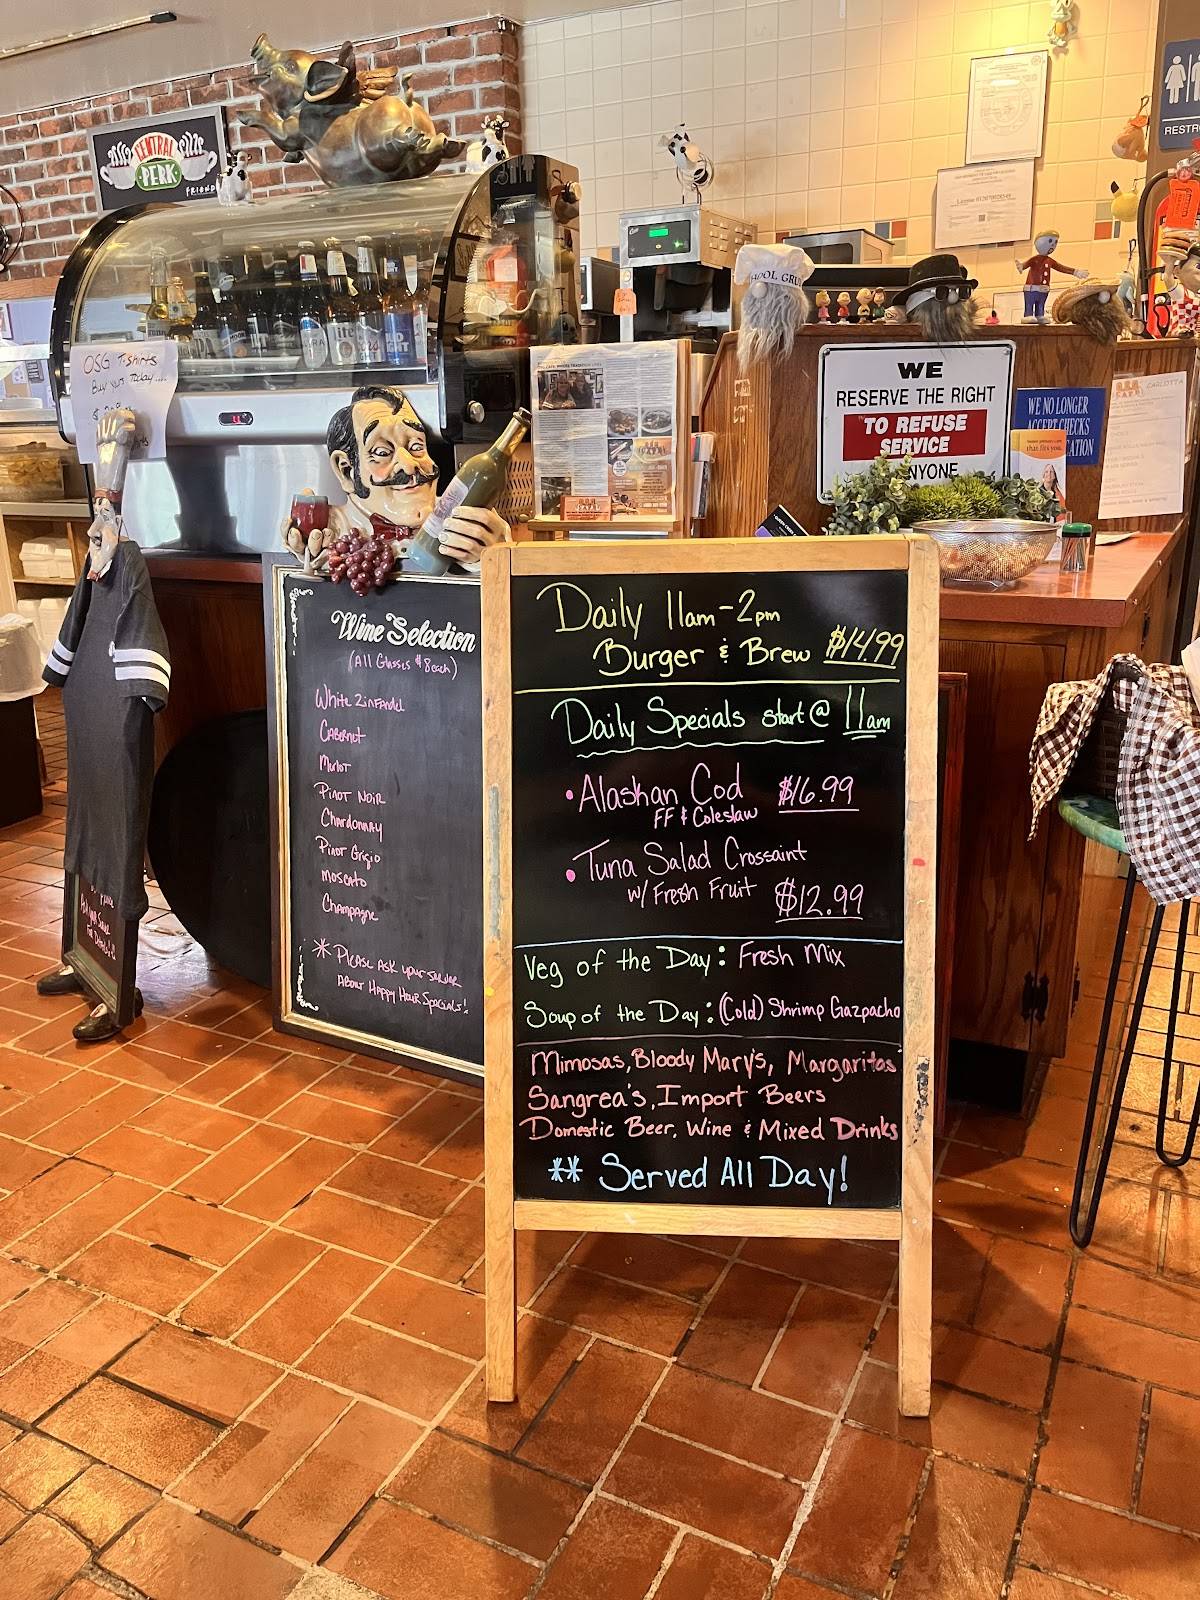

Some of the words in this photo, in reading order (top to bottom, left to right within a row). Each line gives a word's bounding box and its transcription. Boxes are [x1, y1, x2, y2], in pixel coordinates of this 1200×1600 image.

[1164, 124, 1200, 135] RESTR
[134, 135, 174, 161] CENTRAL
[141, 163, 177, 187] PERK
[185, 185, 217, 197] FRIEND
[897, 361, 944, 379] WE
[836, 388, 909, 407] RESERVE
[916, 387, 944, 405] THE
[951, 386, 996, 403] RIGHT
[1028, 397, 1041, 415] WE
[1043, 397, 1055, 415] NO
[1056, 396, 1089, 414] LONGER
[863, 416, 889, 435] TO
[896, 414, 968, 434] REFUSE
[1028, 418, 1058, 429] ACCEPT
[1059, 417, 1090, 435] CHECKS
[880, 436, 950, 456] SERVICE
[905, 462, 958, 480] NYONE
[536, 581, 644, 641] Daily
[331, 611, 384, 642] Wine
[386, 613, 476, 652] Selection
[348, 650, 372, 674] (All
[376, 653, 410, 670] Glasses
[592, 637, 705, 677] Burger
[719, 638, 730, 664] &
[739, 637, 811, 667] Brew
[824, 624, 905, 663] $14.99
[315, 684, 351, 710] White
[551, 697, 636, 747] Daily
[646, 696, 747, 739] Specials
[761, 697, 805, 727] start
[809, 700, 830, 728] @
[844, 685, 891, 731] 11am
[690, 761, 744, 806] Cod
[778, 775, 855, 807] $16.99
[321, 807, 383, 842] Chardonnay
[654, 806, 676, 829] FF
[692, 803, 758, 828] Coleslaw
[351, 844, 381, 870] Grigio
[572, 839, 638, 883] Tuna
[643, 840, 711, 876] Salad
[724, 836, 808, 870] Crossaint
[322, 893, 379, 924] Champagne
[627, 879, 649, 910] w/
[652, 881, 699, 907] Fresh
[708, 875, 757, 901] Fruit
[774, 877, 865, 917] $12.99
[402, 965, 427, 981] your
[523, 955, 564, 988] Veg
[576, 948, 606, 977] of
[616, 946, 651, 973] the
[655, 944, 726, 977] Day:
[738, 940, 794, 969] Fresh
[804, 942, 846, 968] Mix
[523, 1001, 575, 1030] Soup
[581, 1002, 602, 1024] of
[616, 1000, 646, 1023] the
[648, 1000, 714, 1028] Day:
[718, 991, 764, 1027] (Cold)
[769, 997, 825, 1022] Shrimp
[830, 994, 901, 1021] Gazpacho
[531, 1050, 631, 1077] Mimosas,
[631, 1047, 695, 1074] Bloody
[703, 1045, 773, 1080] Mary's,
[788, 1049, 897, 1083] Margaritas
[528, 1083, 655, 1119] Sangrea's,
[655, 1084, 748, 1113] Import
[757, 1083, 826, 1105] Beers
[518, 1116, 615, 1141] Domestic
[686, 1116, 732, 1138] Wine
[758, 1116, 825, 1141] Mixed
[829, 1115, 899, 1141] Drinks
[599, 1152, 708, 1193] Served
[720, 1157, 753, 1188] All
[759, 1154, 849, 1205] Day!
